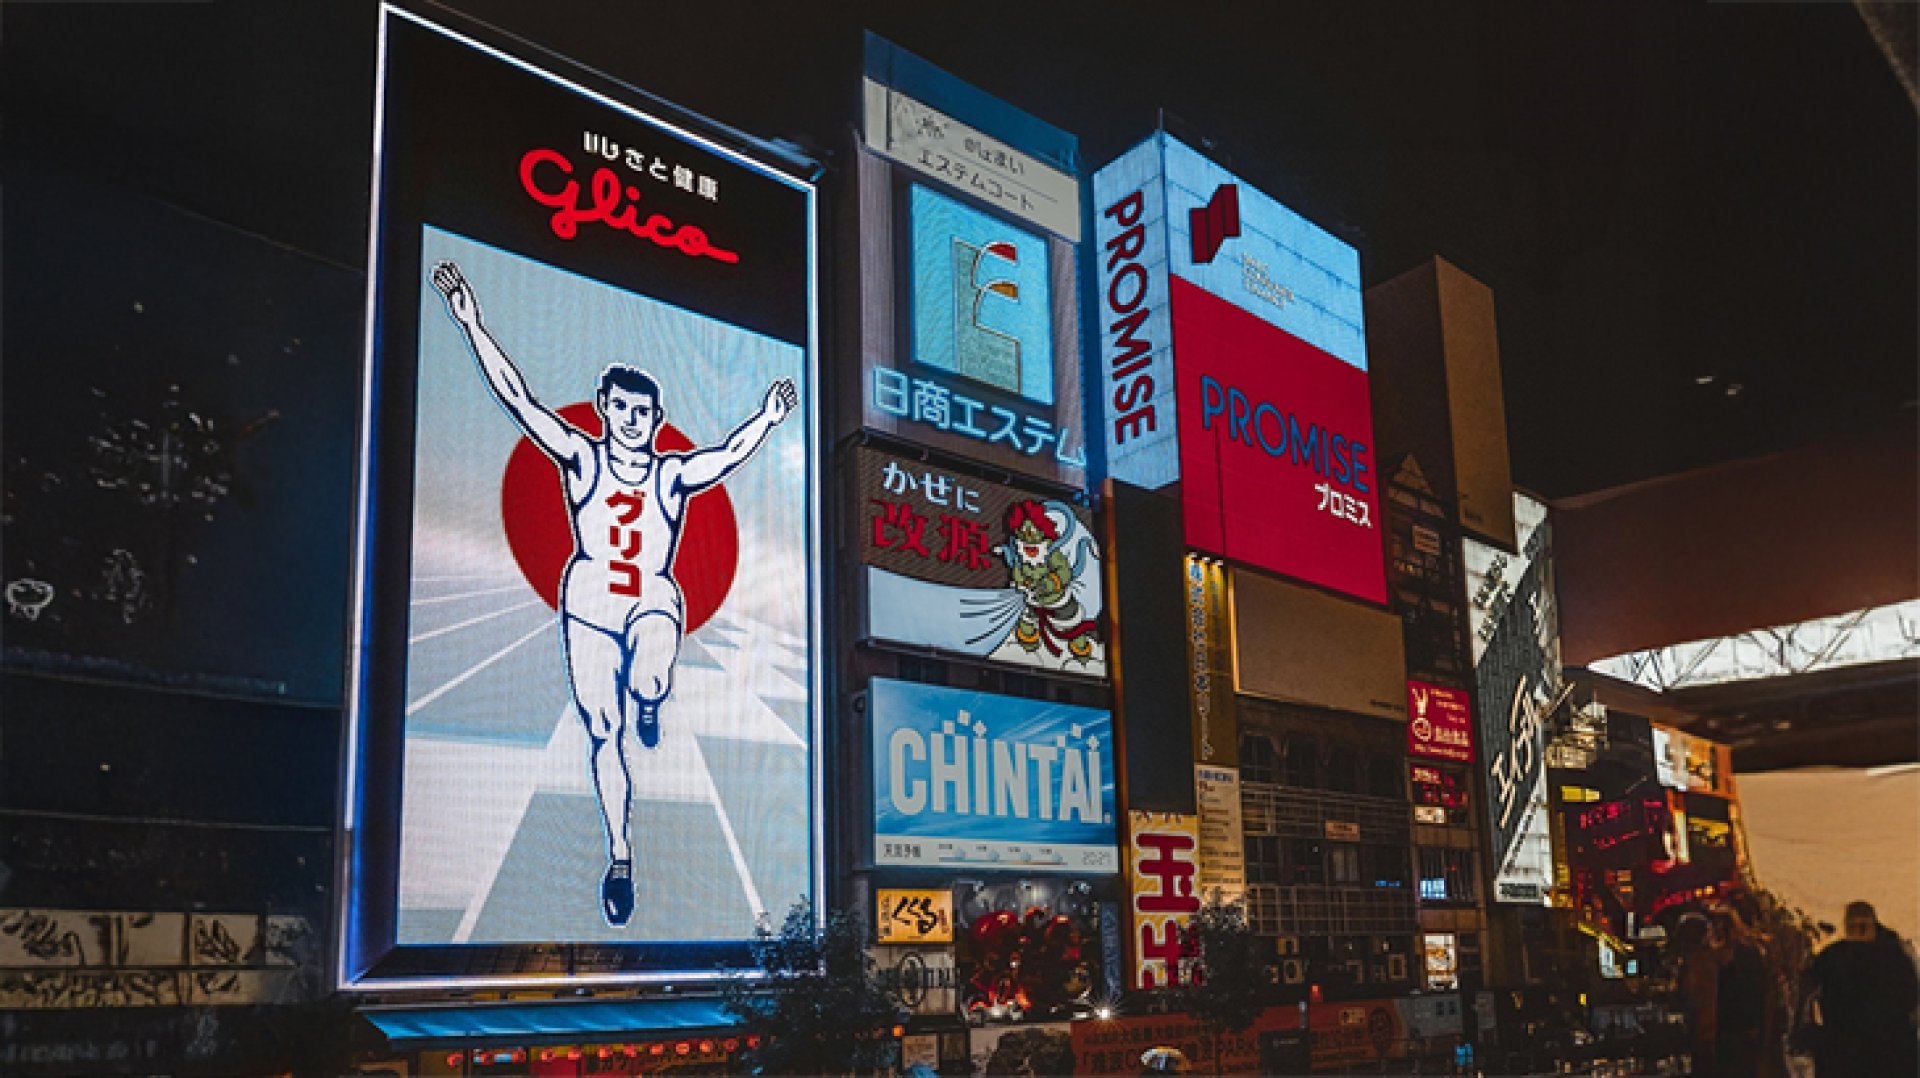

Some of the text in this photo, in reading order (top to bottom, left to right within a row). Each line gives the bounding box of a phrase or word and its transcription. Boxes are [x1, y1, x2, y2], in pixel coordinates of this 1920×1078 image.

[519, 148, 740, 264] Glico
[1104, 190, 1156, 446] PROMISE
[872, 365, 1087, 467] 日商エステム
[1201, 374, 1370, 494] PROMISE
[870, 497, 993, 570] 改源
[881, 460, 981, 514] かぜに
[1313, 481, 1374, 529] プロミス
[604, 488, 647, 598] グリコ
